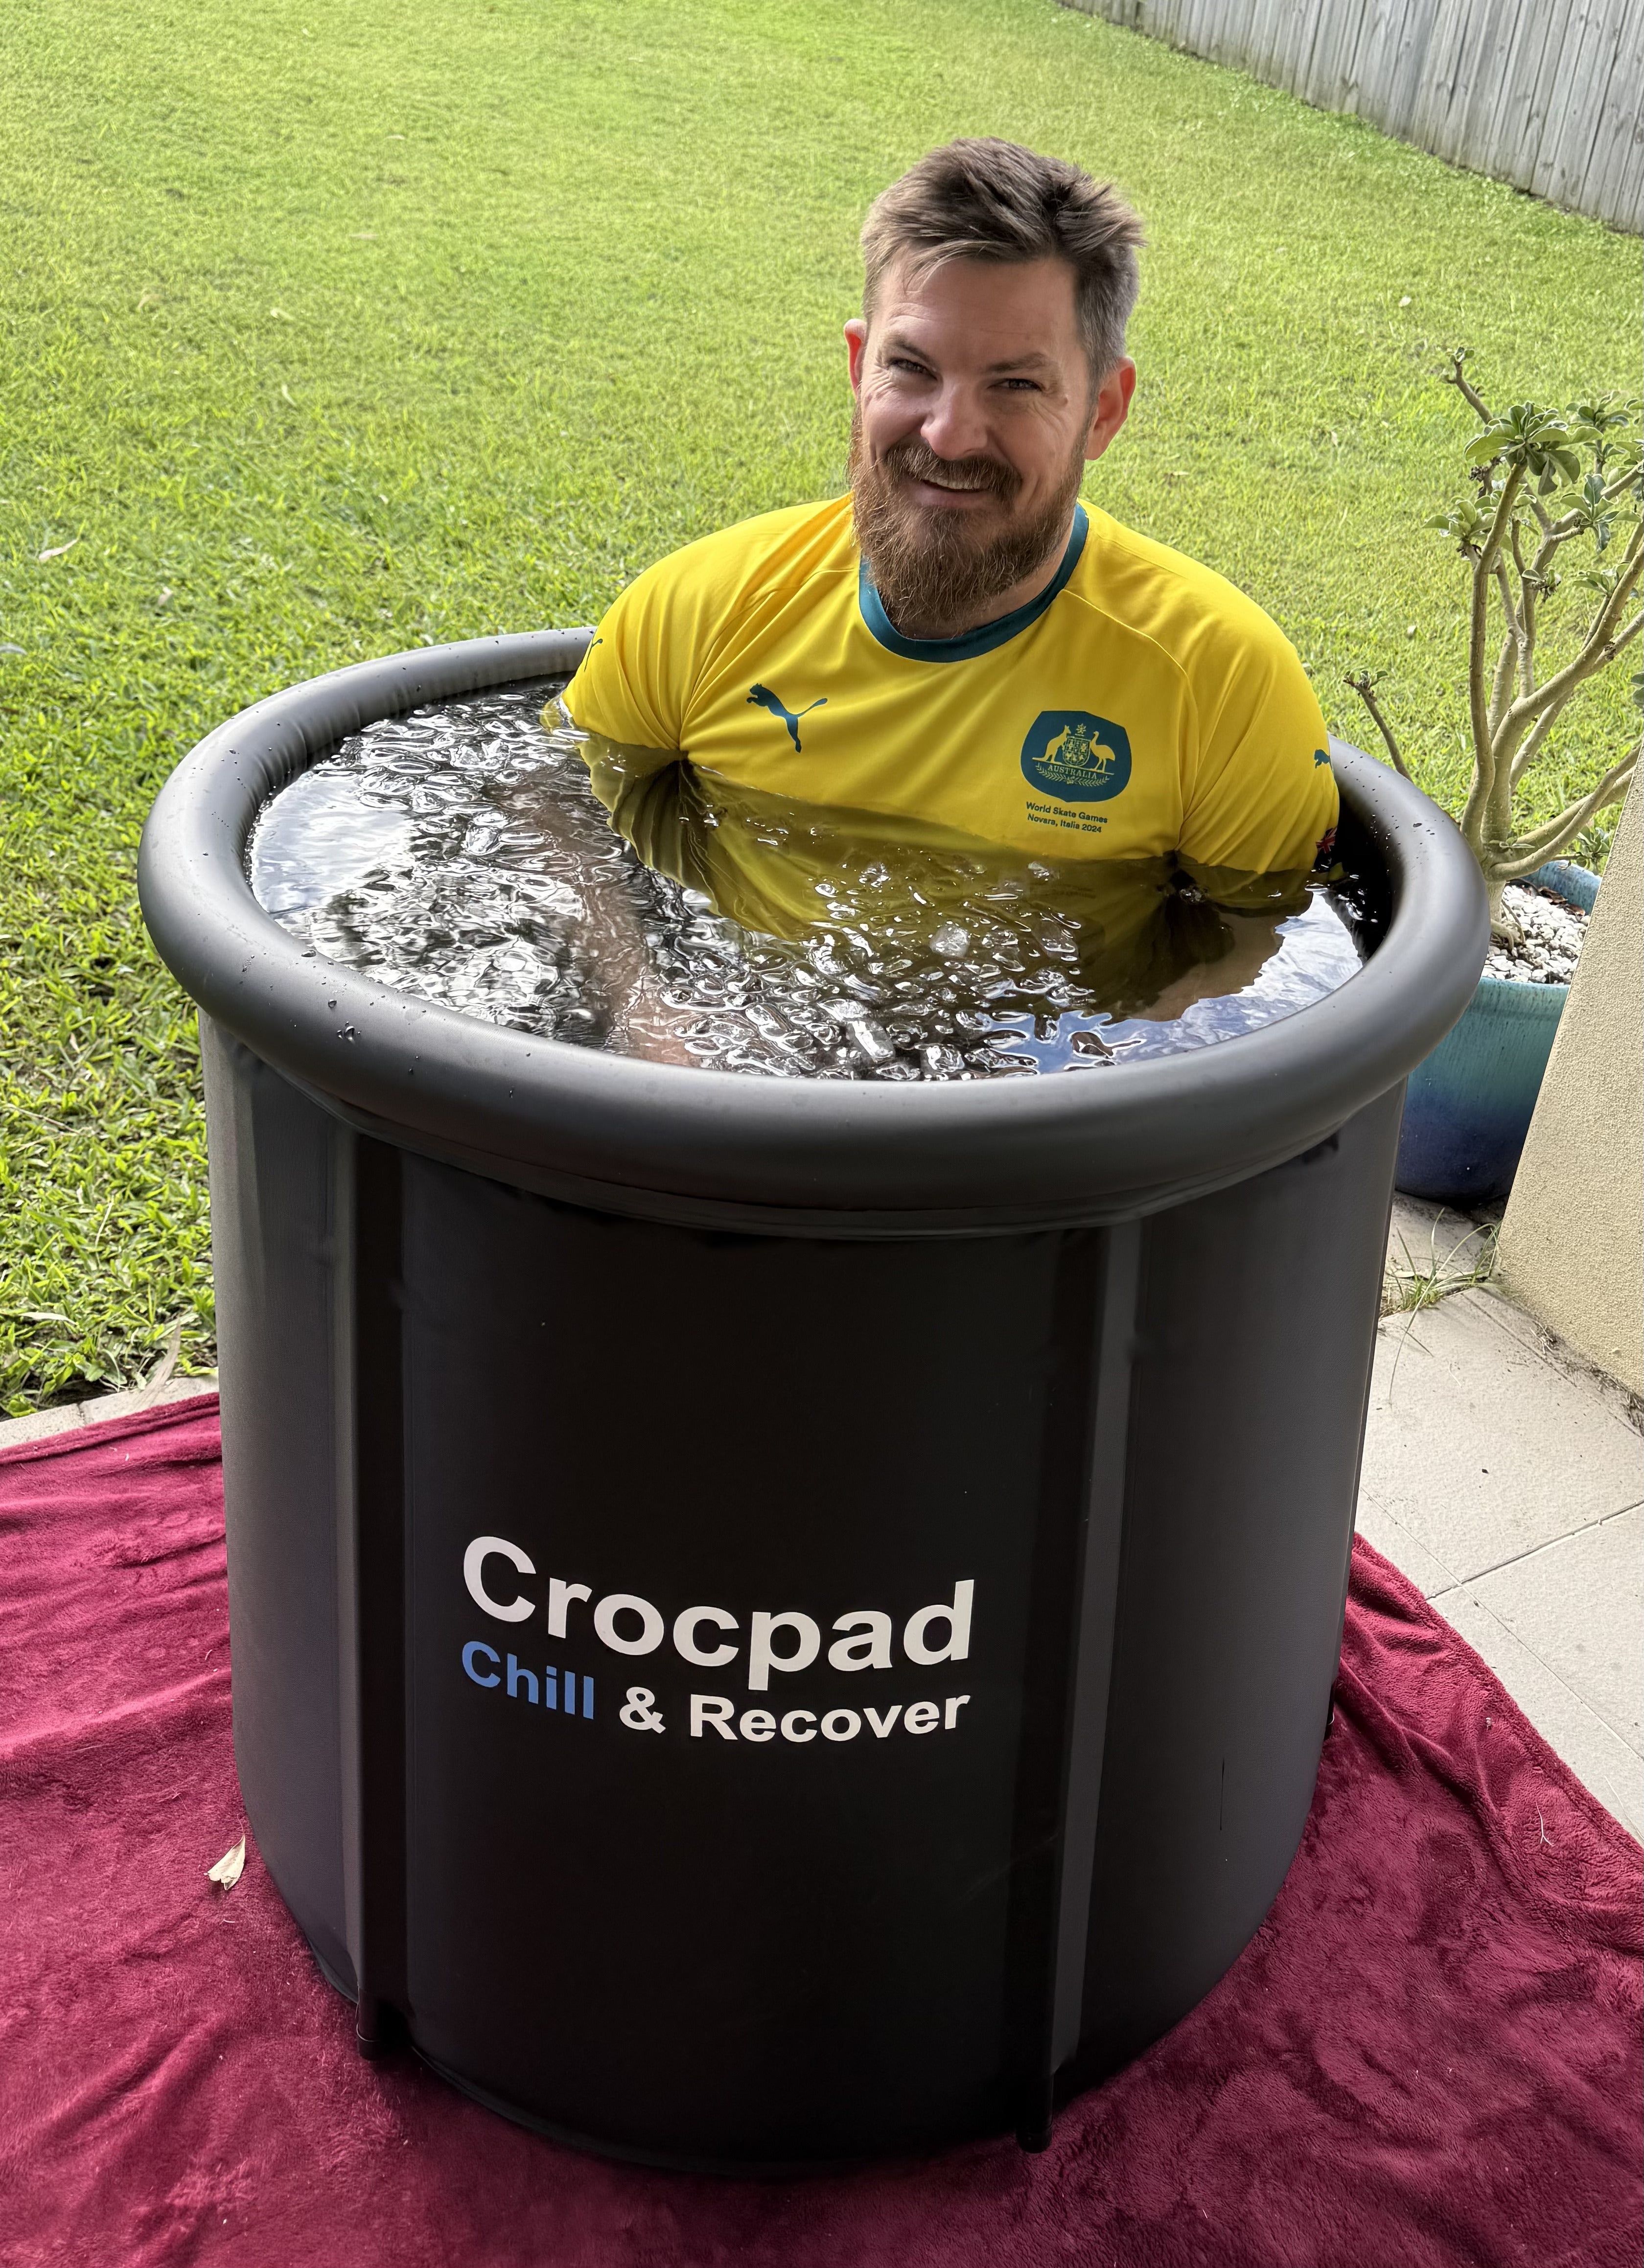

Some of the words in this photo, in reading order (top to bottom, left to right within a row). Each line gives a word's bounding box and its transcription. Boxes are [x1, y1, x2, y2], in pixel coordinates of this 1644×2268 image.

[1048, 764, 1097, 779] AUSTRALIA
[1026, 801, 1051, 813] World
[1053, 807, 1077, 818] Skate
[1079, 812, 1108, 823] Games
[1027, 813, 1058, 827] Novara,
[1060, 819, 1080, 830] Italia
[1082, 824, 1102, 833] 2024
[463, 1535, 975, 1691] Crocpad
[461, 1641, 594, 1720] Chill
[619, 1687, 666, 1734] &
[690, 1693, 971, 1743] Recover
